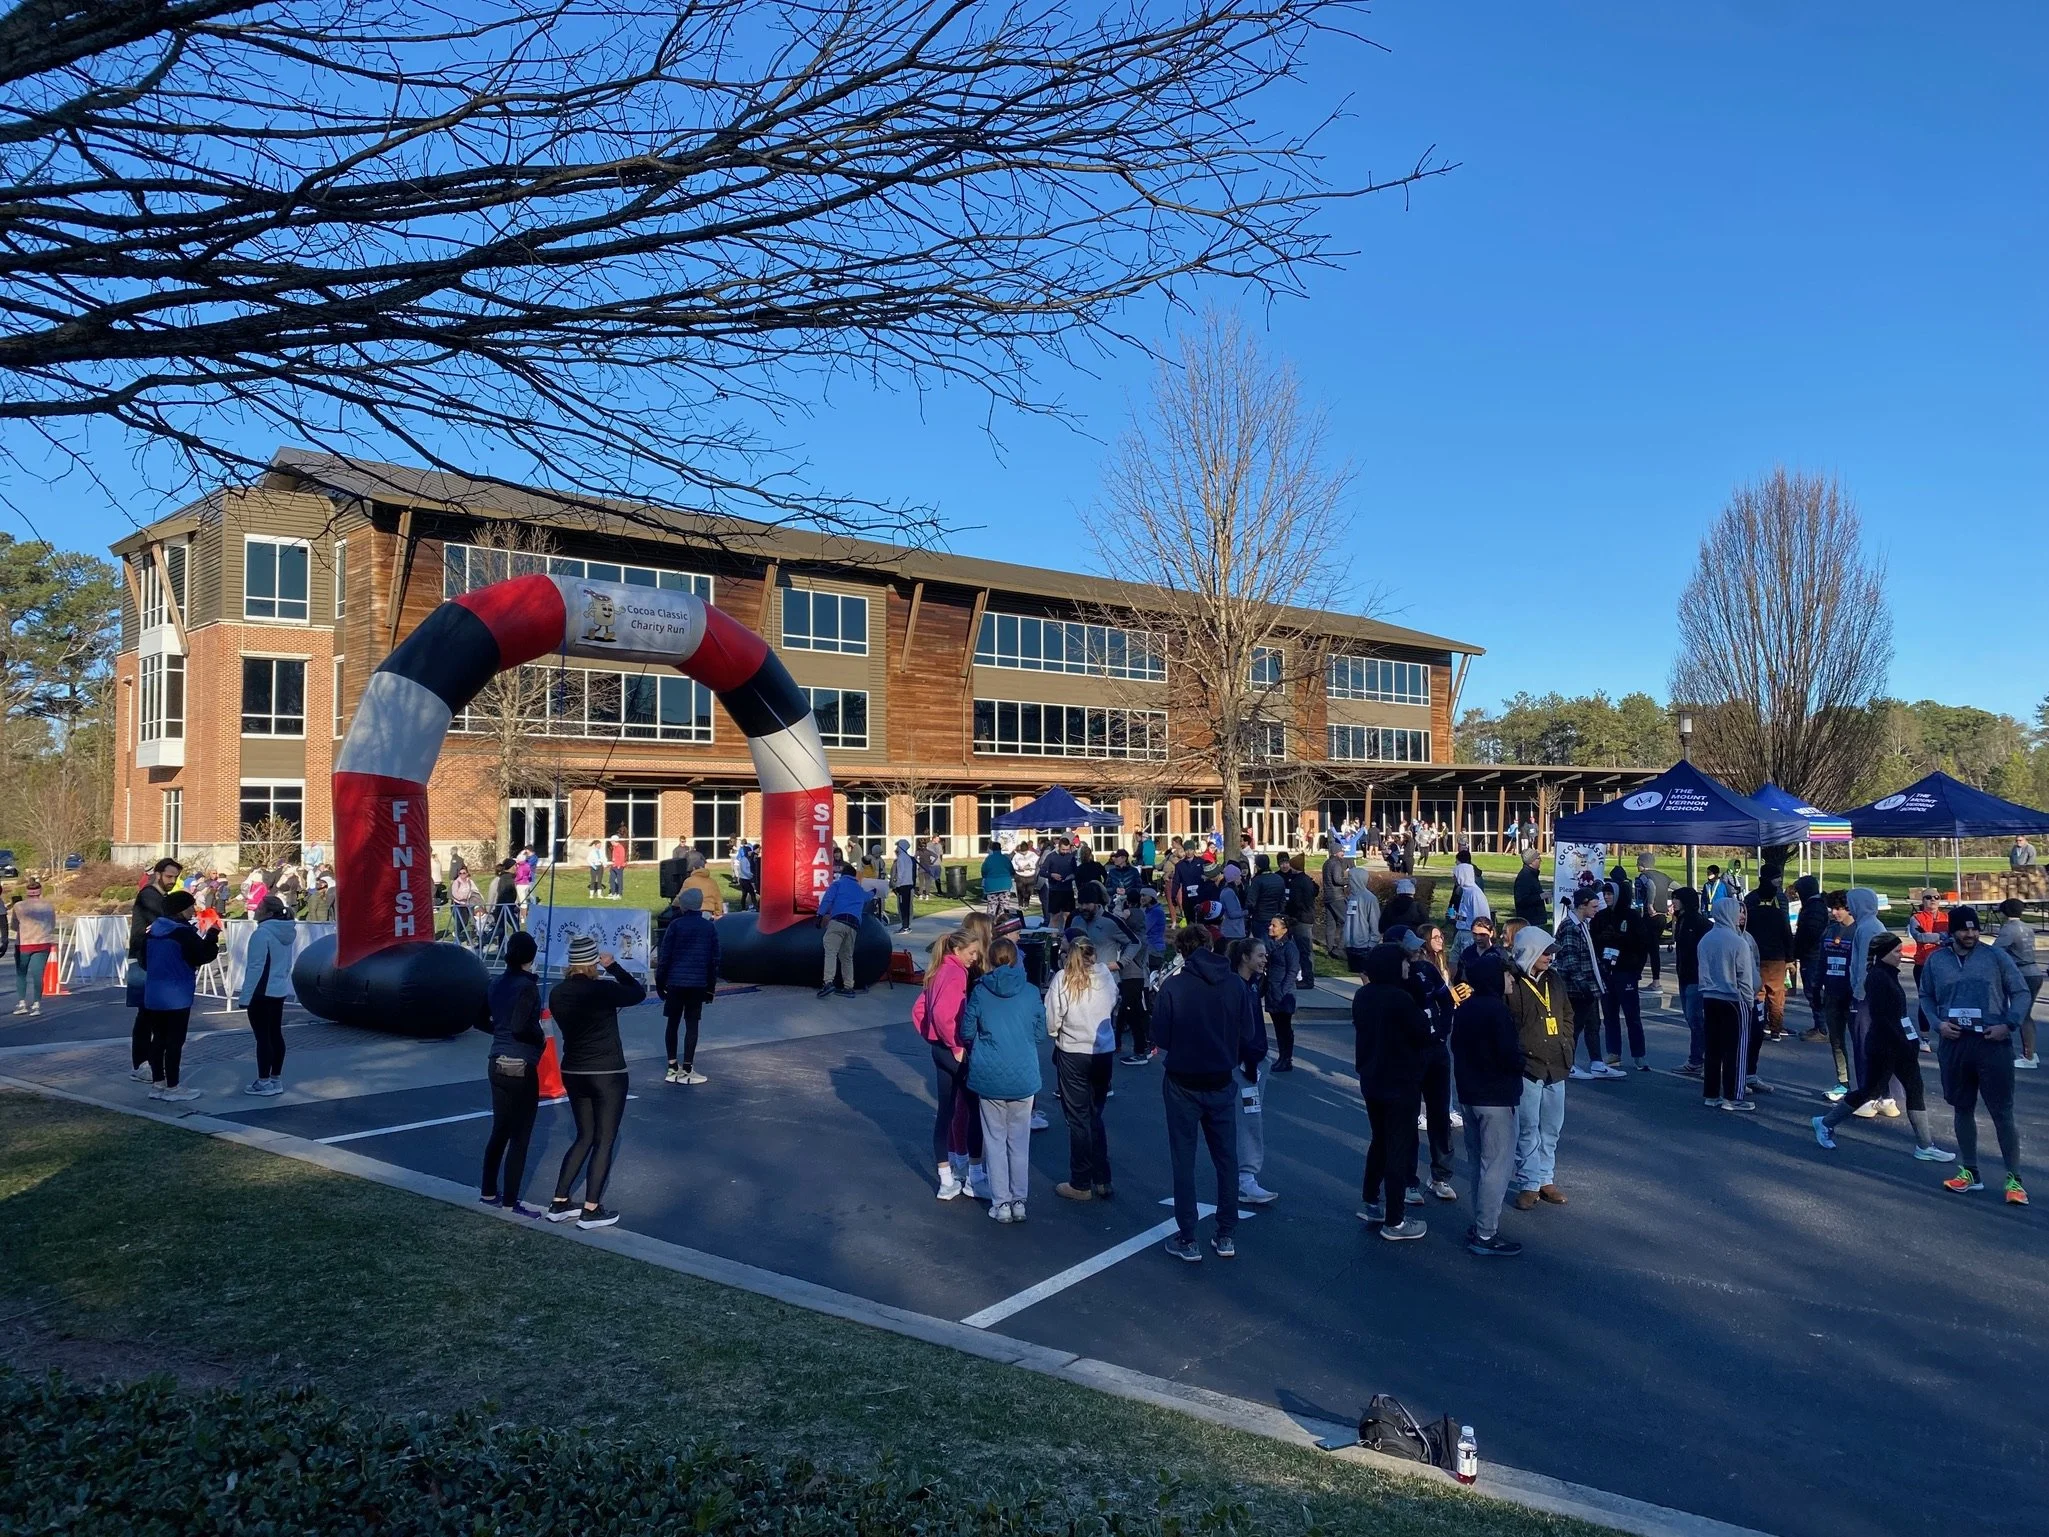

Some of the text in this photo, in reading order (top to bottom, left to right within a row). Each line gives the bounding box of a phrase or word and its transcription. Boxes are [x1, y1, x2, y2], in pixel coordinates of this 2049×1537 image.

[627, 605, 688, 620] Cocoa Classic
[631, 620, 685, 634] Charity Run
[1558, 842, 1580, 866] COCOA
[392, 800, 415, 937] FINISH
[1957, 1017, 1972, 1026] 935
